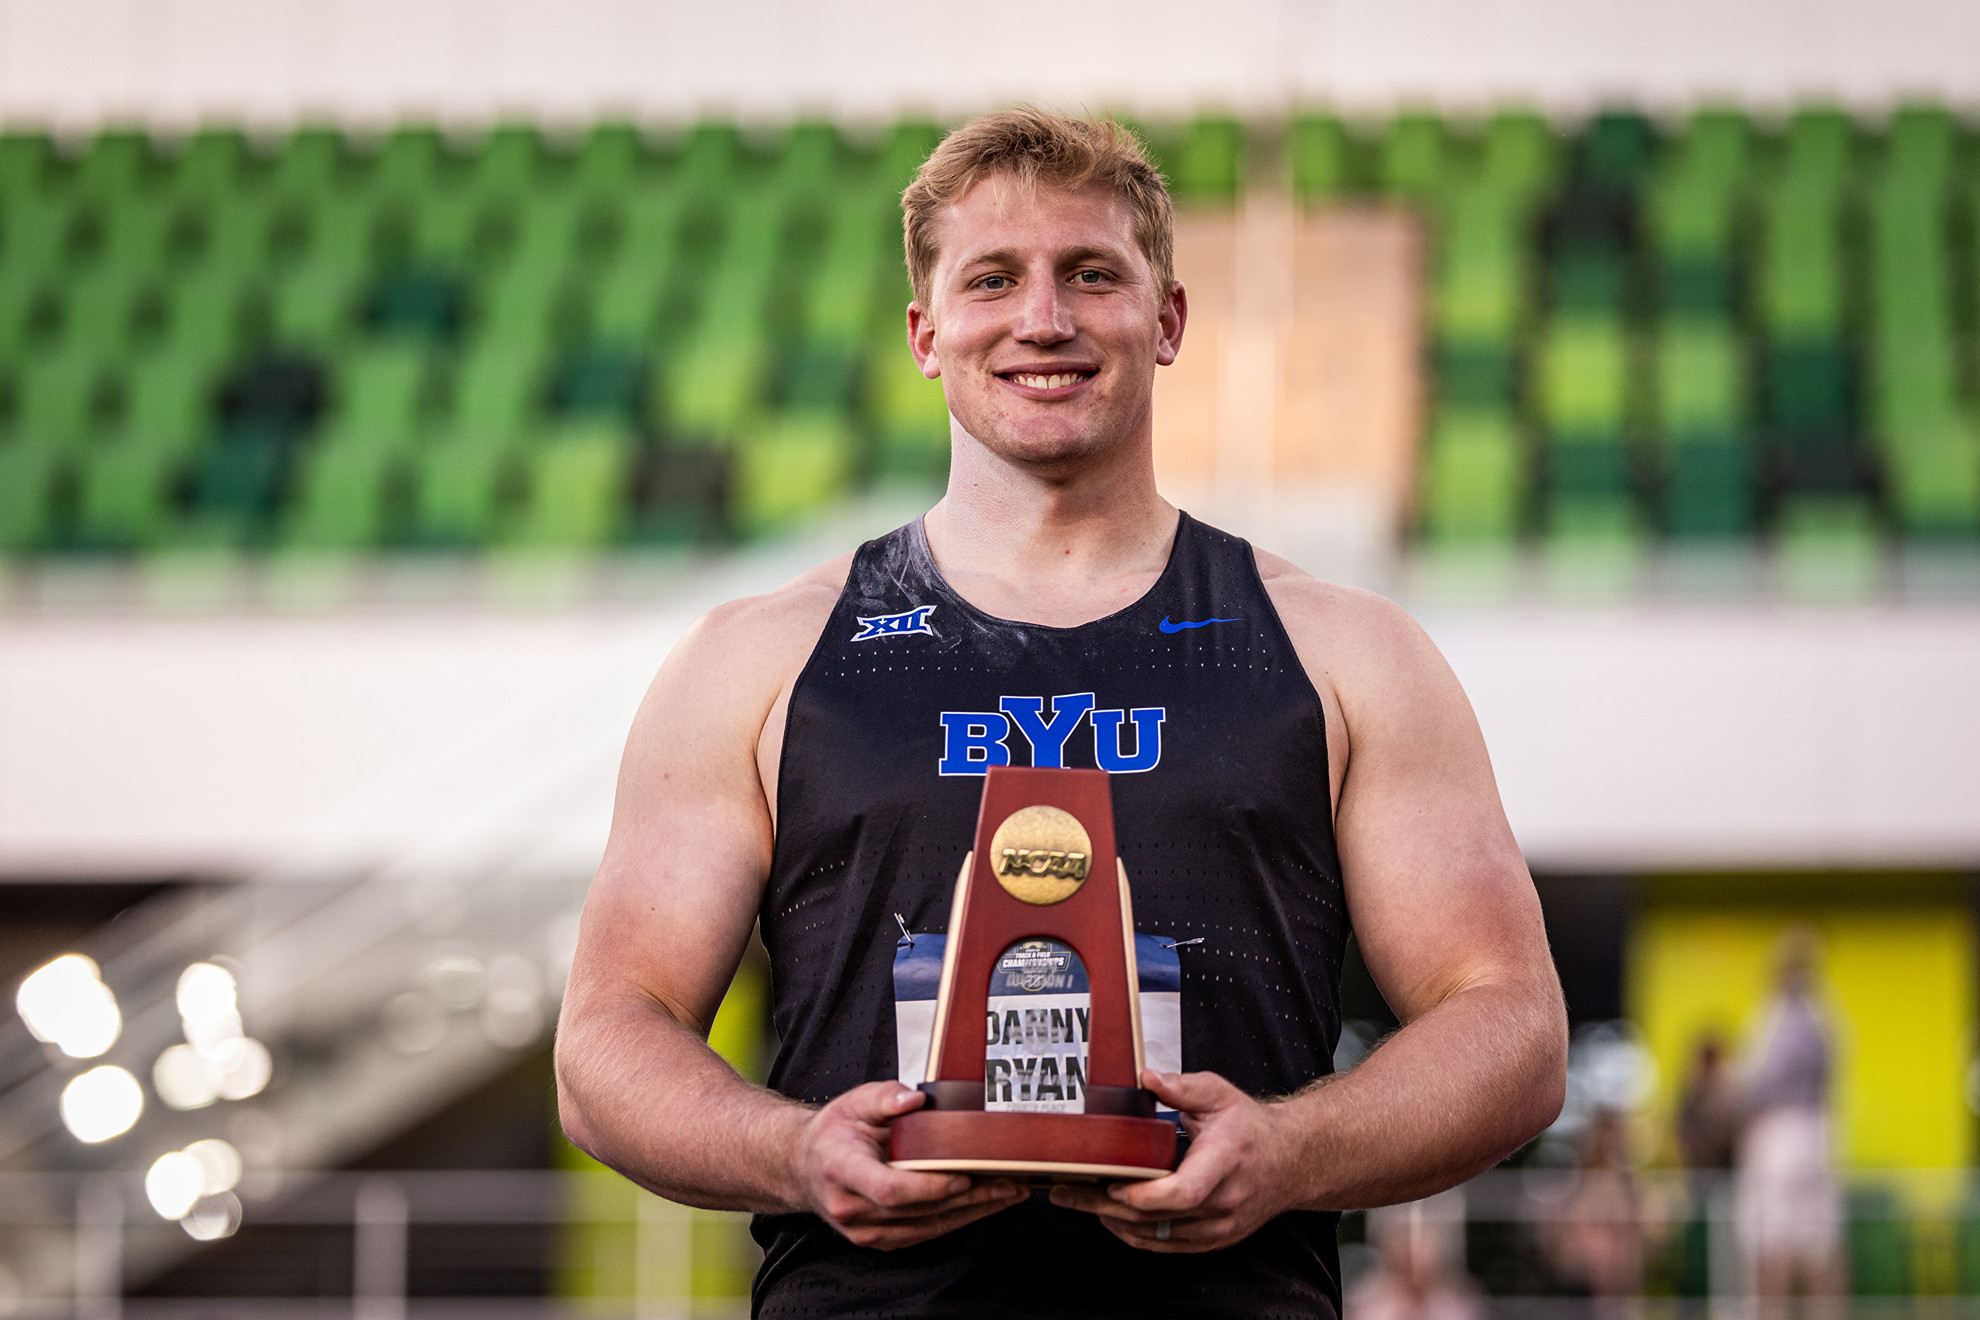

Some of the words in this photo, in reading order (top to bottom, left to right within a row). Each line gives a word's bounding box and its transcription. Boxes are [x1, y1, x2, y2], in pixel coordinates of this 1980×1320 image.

[939, 692, 1167, 776] BYU
[999, 848, 1086, 881] NCAA
[1002, 957, 1065, 968] CHAMPIONSHIPS
[987, 1008, 1089, 1045] DANNY
[986, 1056, 1087, 1102] RYAN
